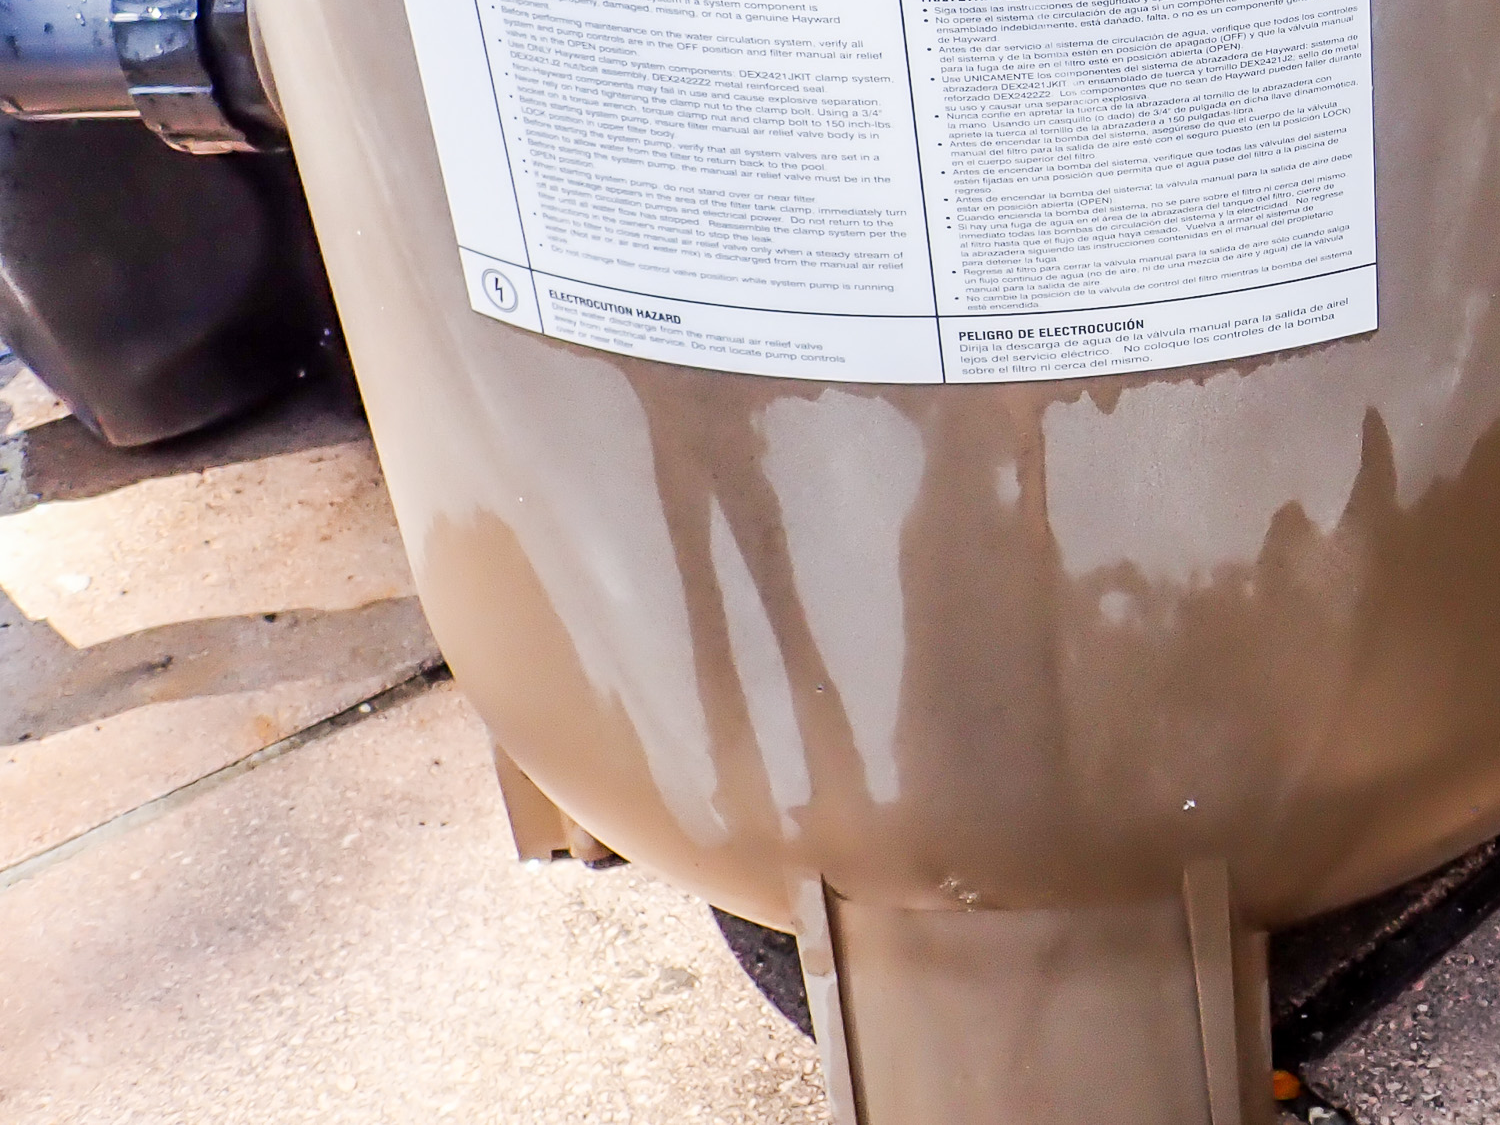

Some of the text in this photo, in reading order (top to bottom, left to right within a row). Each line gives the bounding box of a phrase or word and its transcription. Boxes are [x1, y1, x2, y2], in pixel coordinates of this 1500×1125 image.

[548, 289, 681, 325] ELECTROCUTION HAZARD
[958, 318, 1144, 341] PELIGRO DE ELECTROCUCIÓN
[960, 313, 1334, 365] lejos del servicio eléctrico. No coloque los controles de la bomba
[961, 355, 1152, 375] sobre el filtro ni cerca del mismo.
